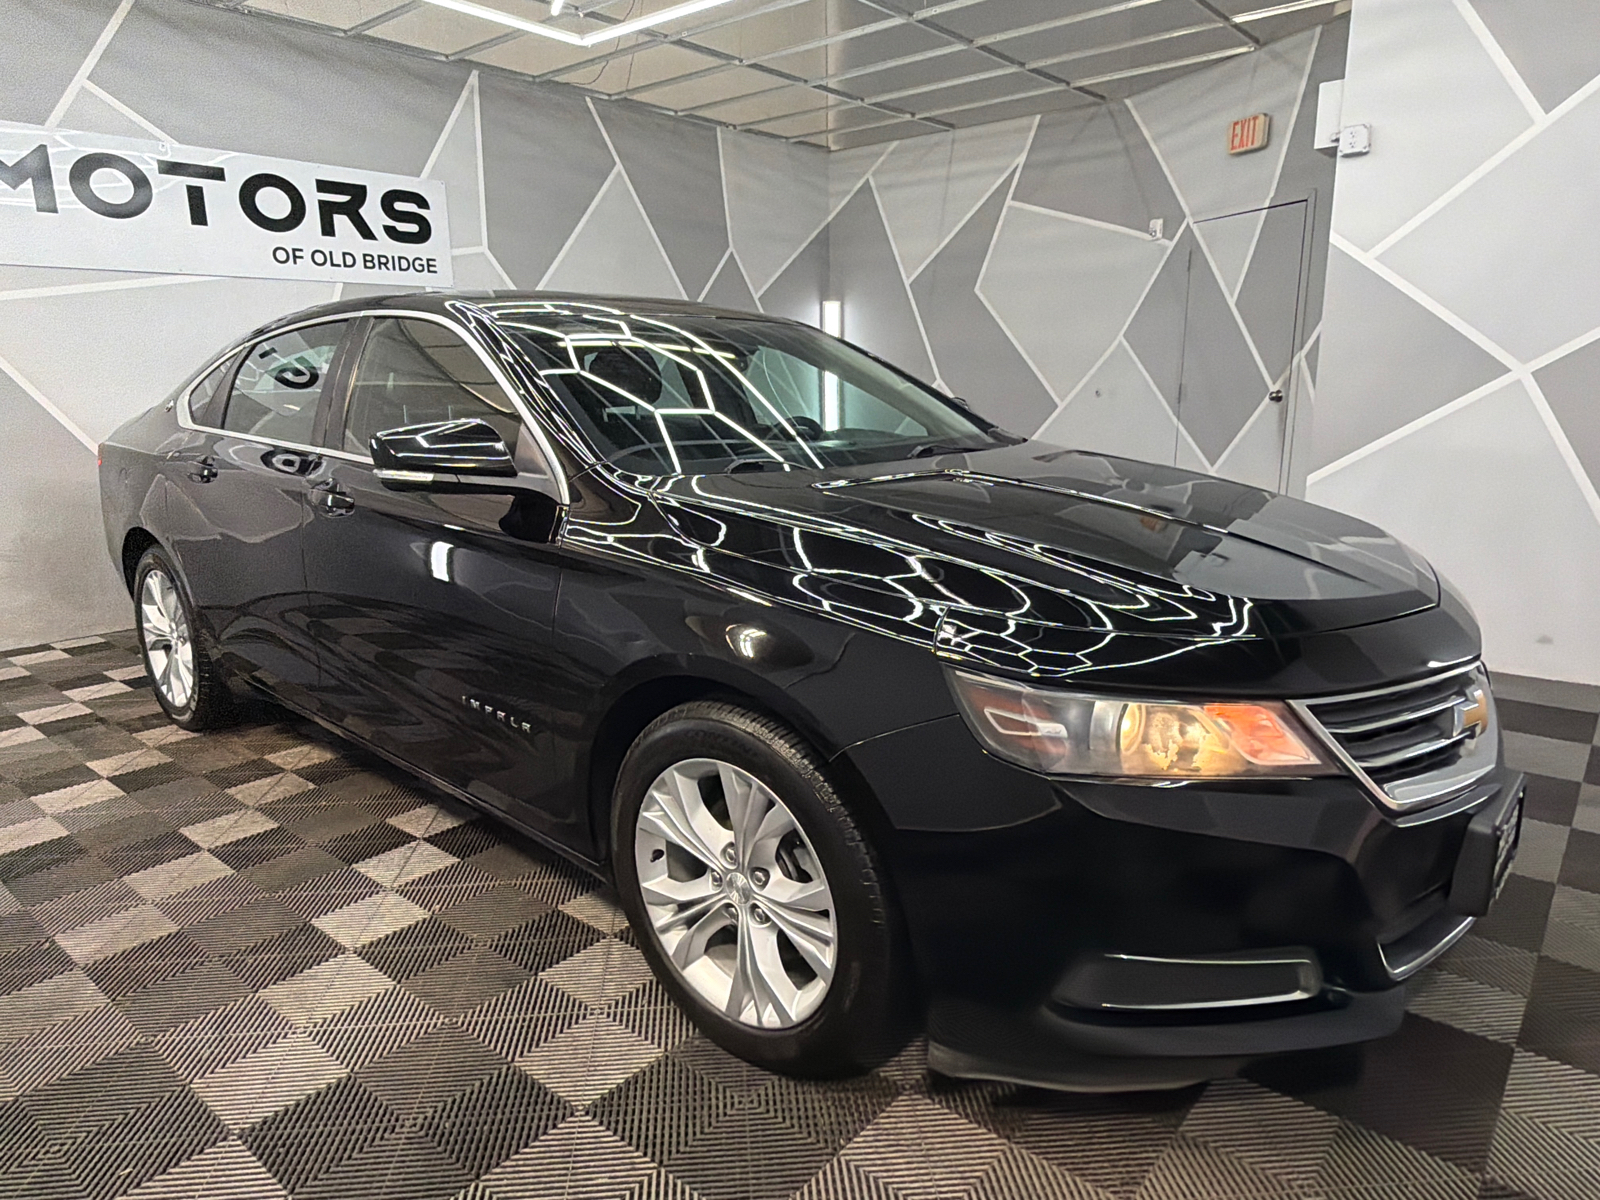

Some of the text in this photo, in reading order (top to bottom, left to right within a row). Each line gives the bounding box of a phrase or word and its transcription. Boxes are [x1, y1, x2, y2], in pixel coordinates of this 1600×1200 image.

[1231, 116, 1259, 151] EXIT
[0, 144, 432, 245] MOTORS
[272, 246, 438, 274] OF OLD BRIDGE
